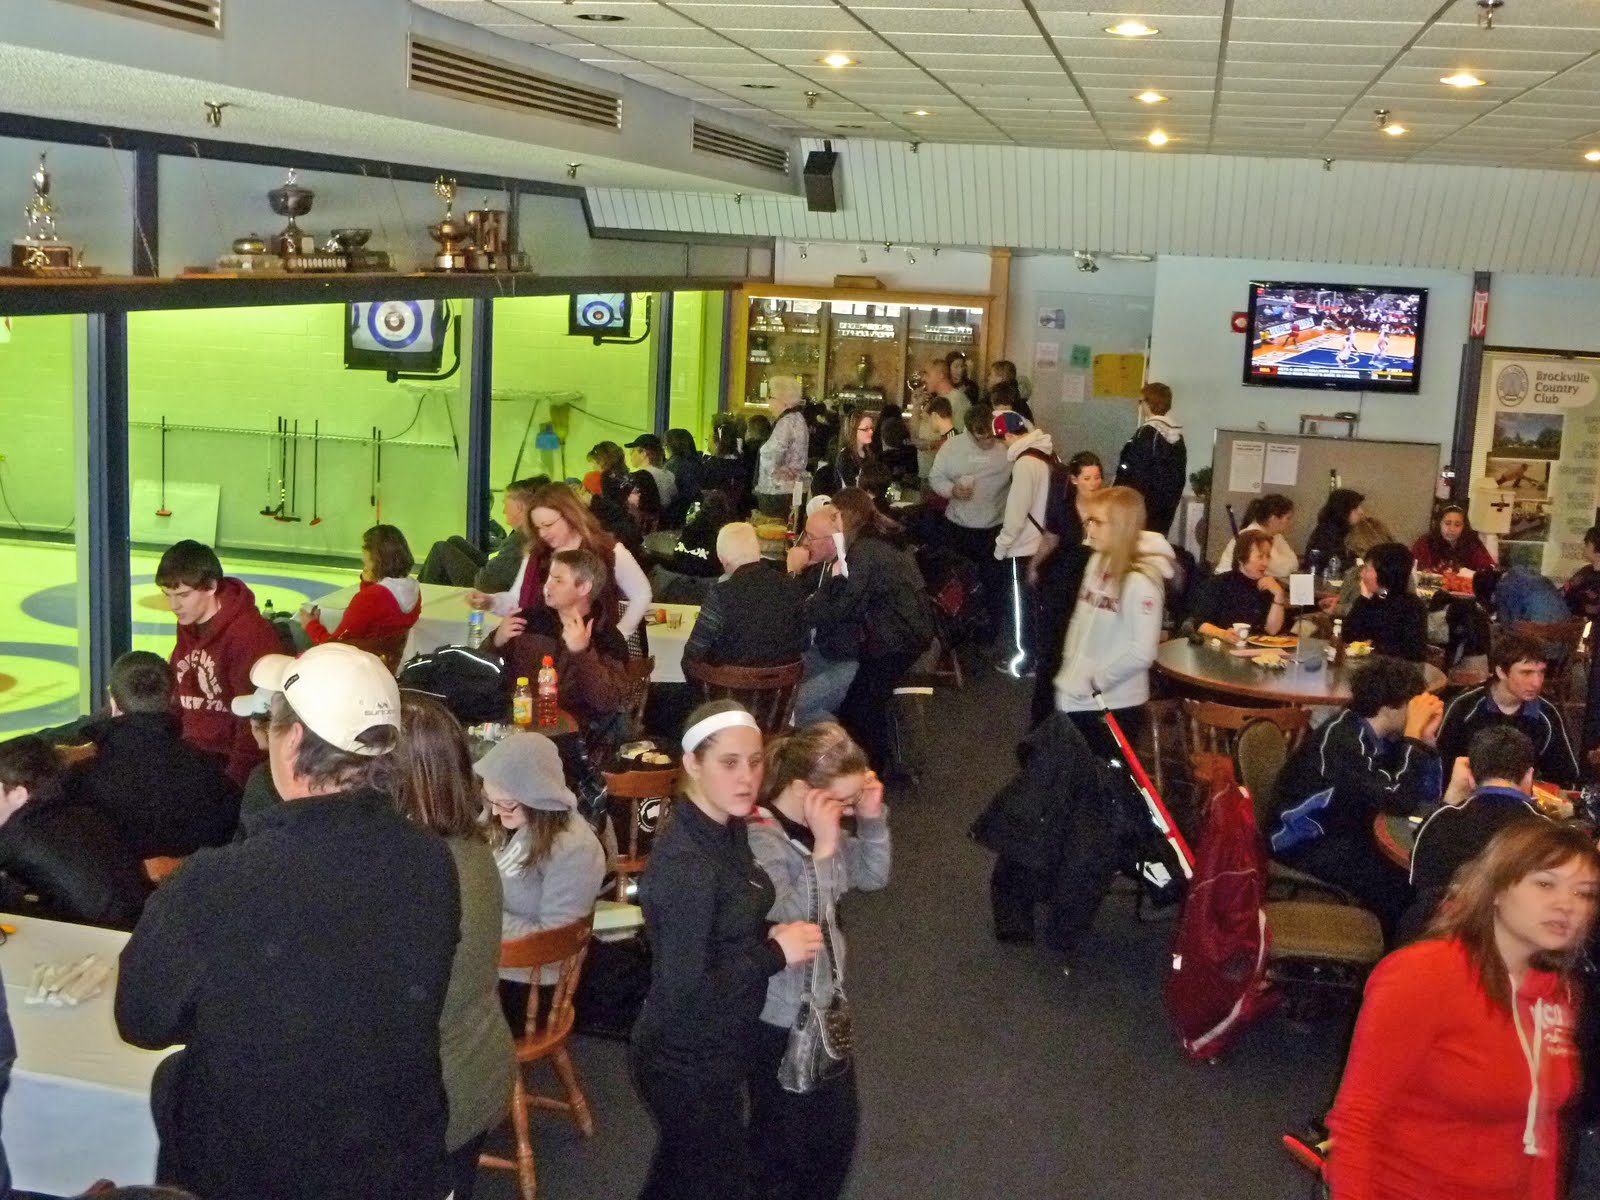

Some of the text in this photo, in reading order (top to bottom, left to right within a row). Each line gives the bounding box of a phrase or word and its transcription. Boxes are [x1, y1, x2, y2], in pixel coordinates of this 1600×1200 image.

[1536, 370, 1590, 383] Brockville
[1535, 382, 1580, 395] Country
[1534, 393, 1559, 404] Club
